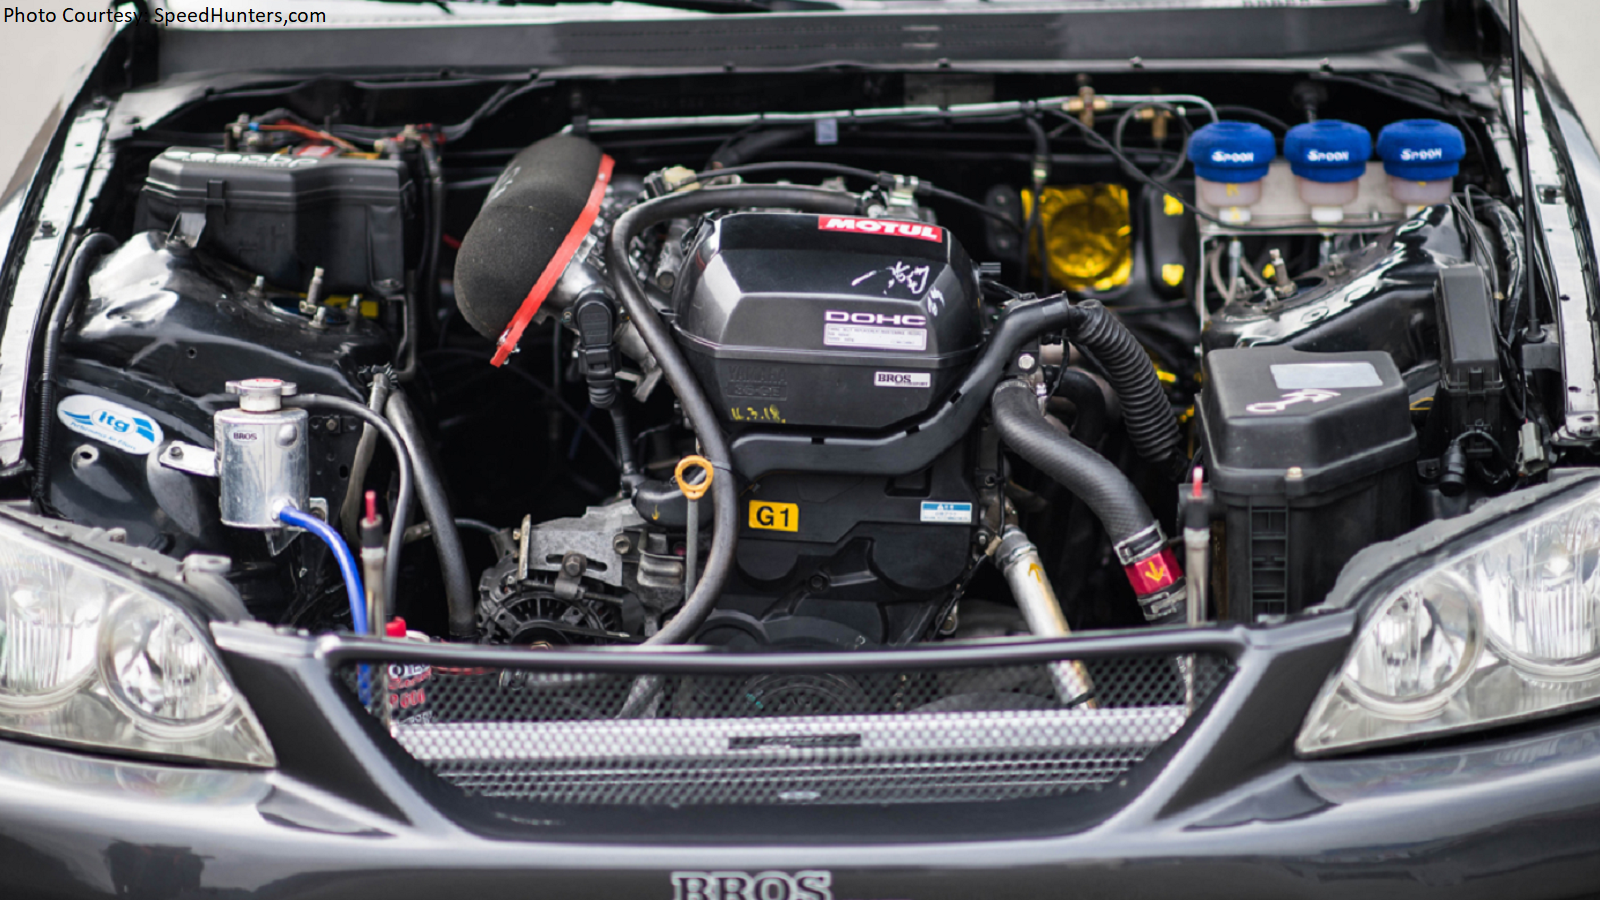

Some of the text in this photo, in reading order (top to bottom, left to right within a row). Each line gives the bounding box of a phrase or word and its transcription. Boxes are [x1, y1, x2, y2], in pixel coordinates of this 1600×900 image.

[825, 218, 938, 240] MOTUL
[825, 311, 927, 326] DOHC
[877, 373, 912, 383] BROS
[233, 432, 258, 441] BROS
[756, 506, 789, 528] G1
[671, 870, 832, 900] BROS
